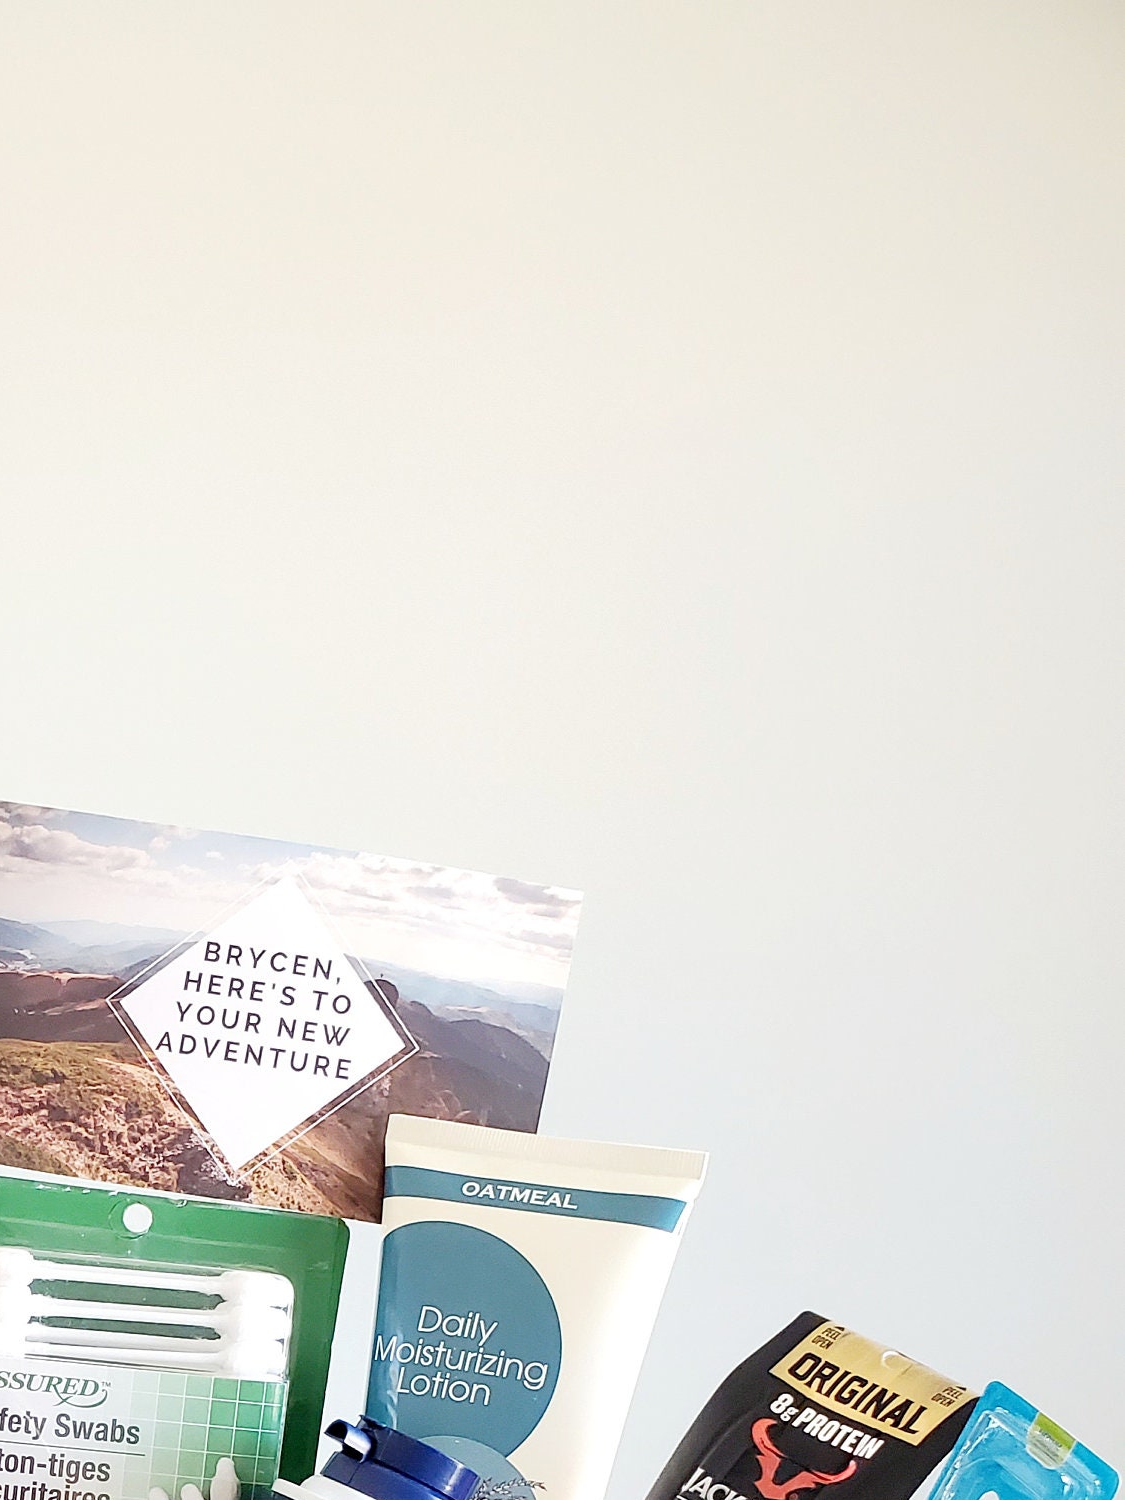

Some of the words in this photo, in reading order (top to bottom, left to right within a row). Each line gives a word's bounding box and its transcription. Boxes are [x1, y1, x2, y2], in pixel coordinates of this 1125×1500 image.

[204, 941, 342, 985] BRYCEN,
[183, 971, 295, 1007] HERE'S
[312, 990, 352, 1015] TO
[176, 1001, 262, 1033] YOUR
[277, 1017, 351, 1047] NEW
[155, 1032, 352, 1080] ADVENTURE
[461, 1181, 578, 1210] OATMEAL
[417, 1305, 499, 1347] Daily
[811, 1333, 835, 1350] OPEN
[822, 1327, 842, 1341] PEEL
[374, 1335, 549, 1391] Moisturizing
[395, 1366, 491, 1407] Lotion
[787, 1352, 929, 1436] ORIGINAL
[54, 1413, 141, 1445] Swabs
[769, 1392, 792, 1422] 8g
[792, 1405, 885, 1460] PROTEIN
